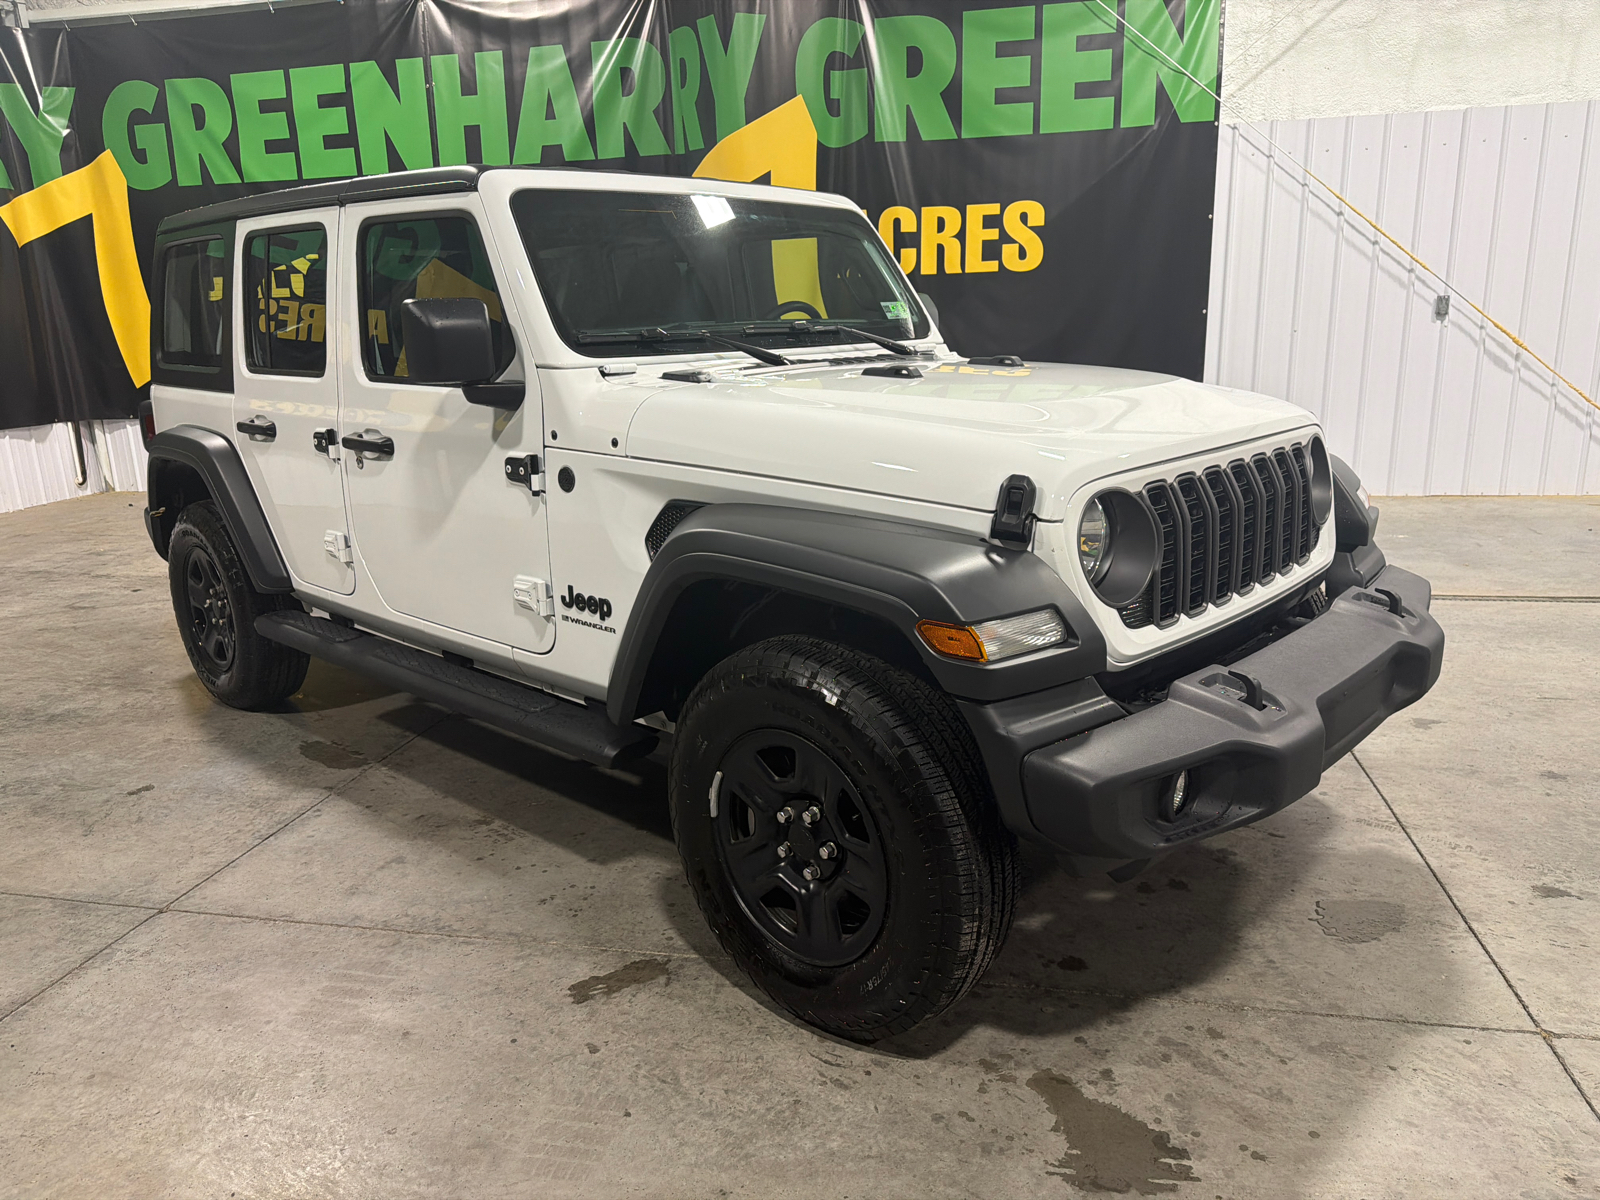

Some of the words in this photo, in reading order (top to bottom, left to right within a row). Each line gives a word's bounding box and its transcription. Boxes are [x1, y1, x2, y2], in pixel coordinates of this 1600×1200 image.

[796, 0, 1221, 148] GREEN
[863, 200, 1046, 276] CRES
[560, 584, 613, 622] Jeep
[569, 616, 617, 635] WRANGLER
